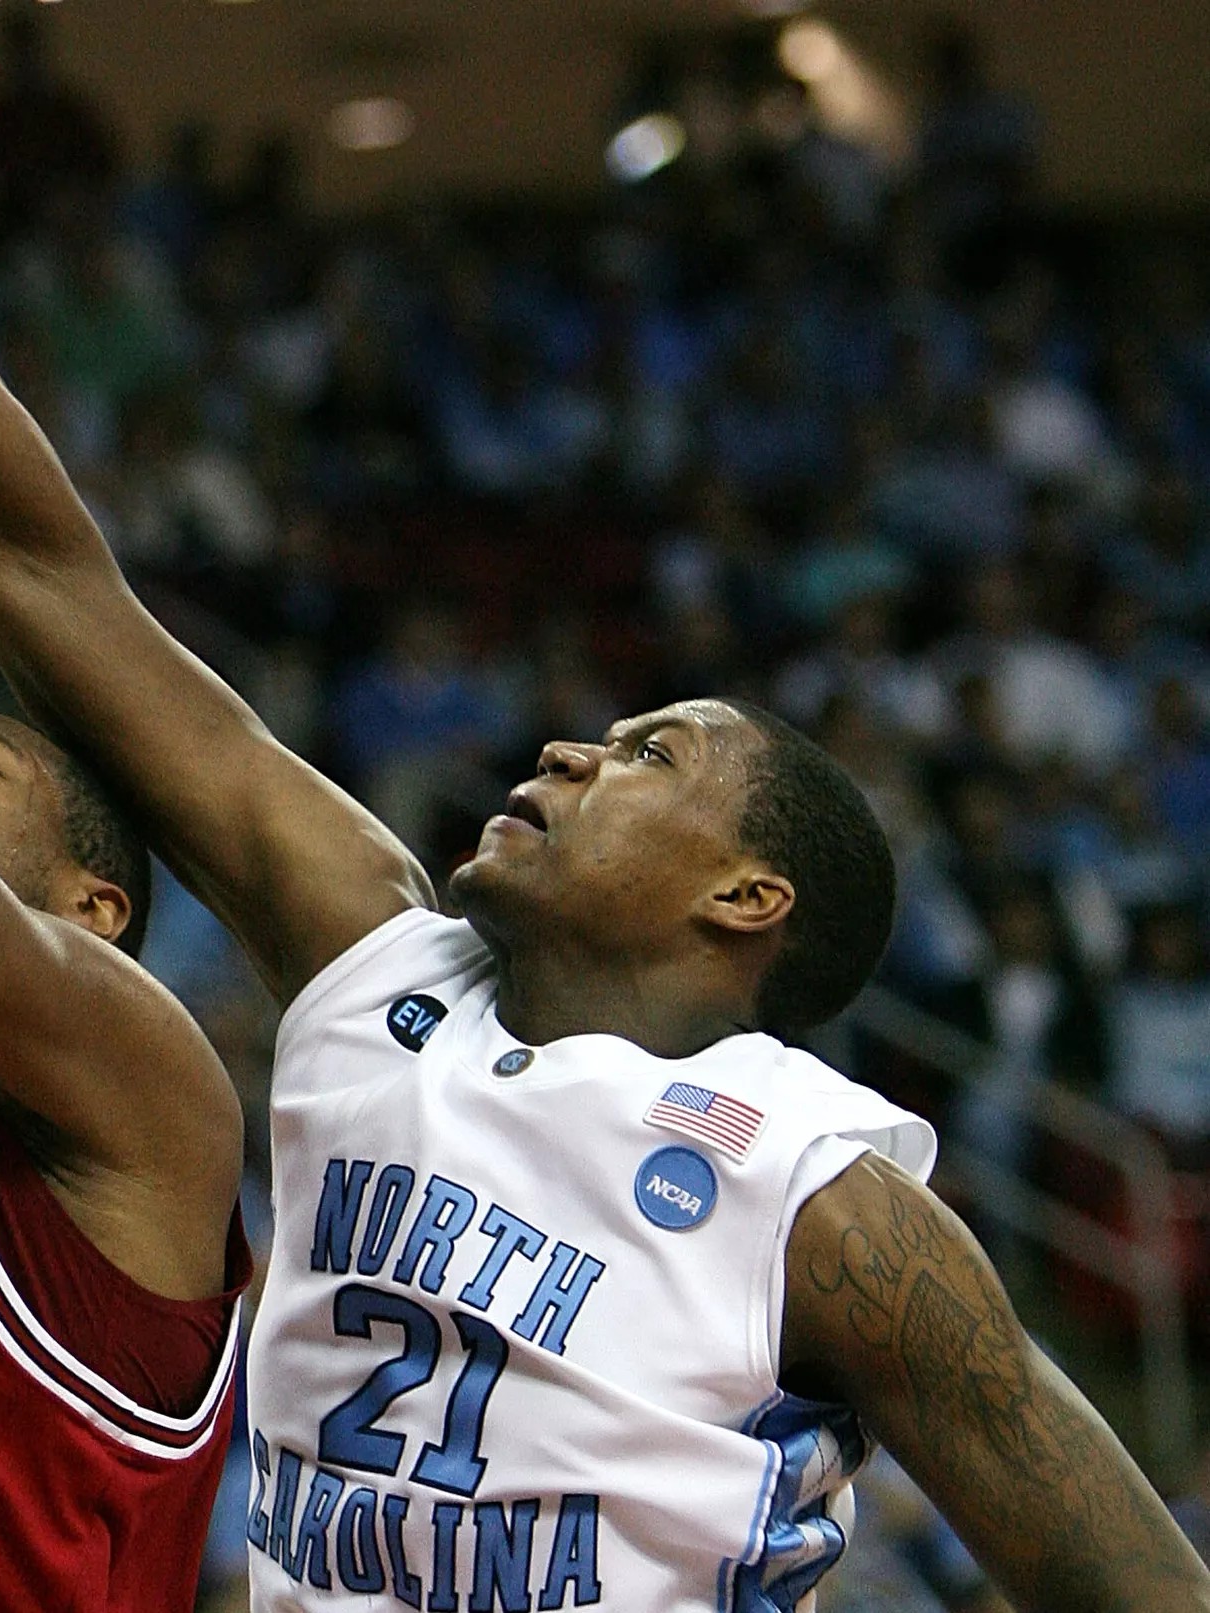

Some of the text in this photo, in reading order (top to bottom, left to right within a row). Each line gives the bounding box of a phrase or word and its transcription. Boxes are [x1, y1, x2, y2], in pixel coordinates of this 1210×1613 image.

[310, 1158, 606, 1356] NORTH
[646, 1175, 702, 1216] NCAA
[316, 1282, 509, 1500] 21
[247, 1428, 602, 1613] CAROLINA
